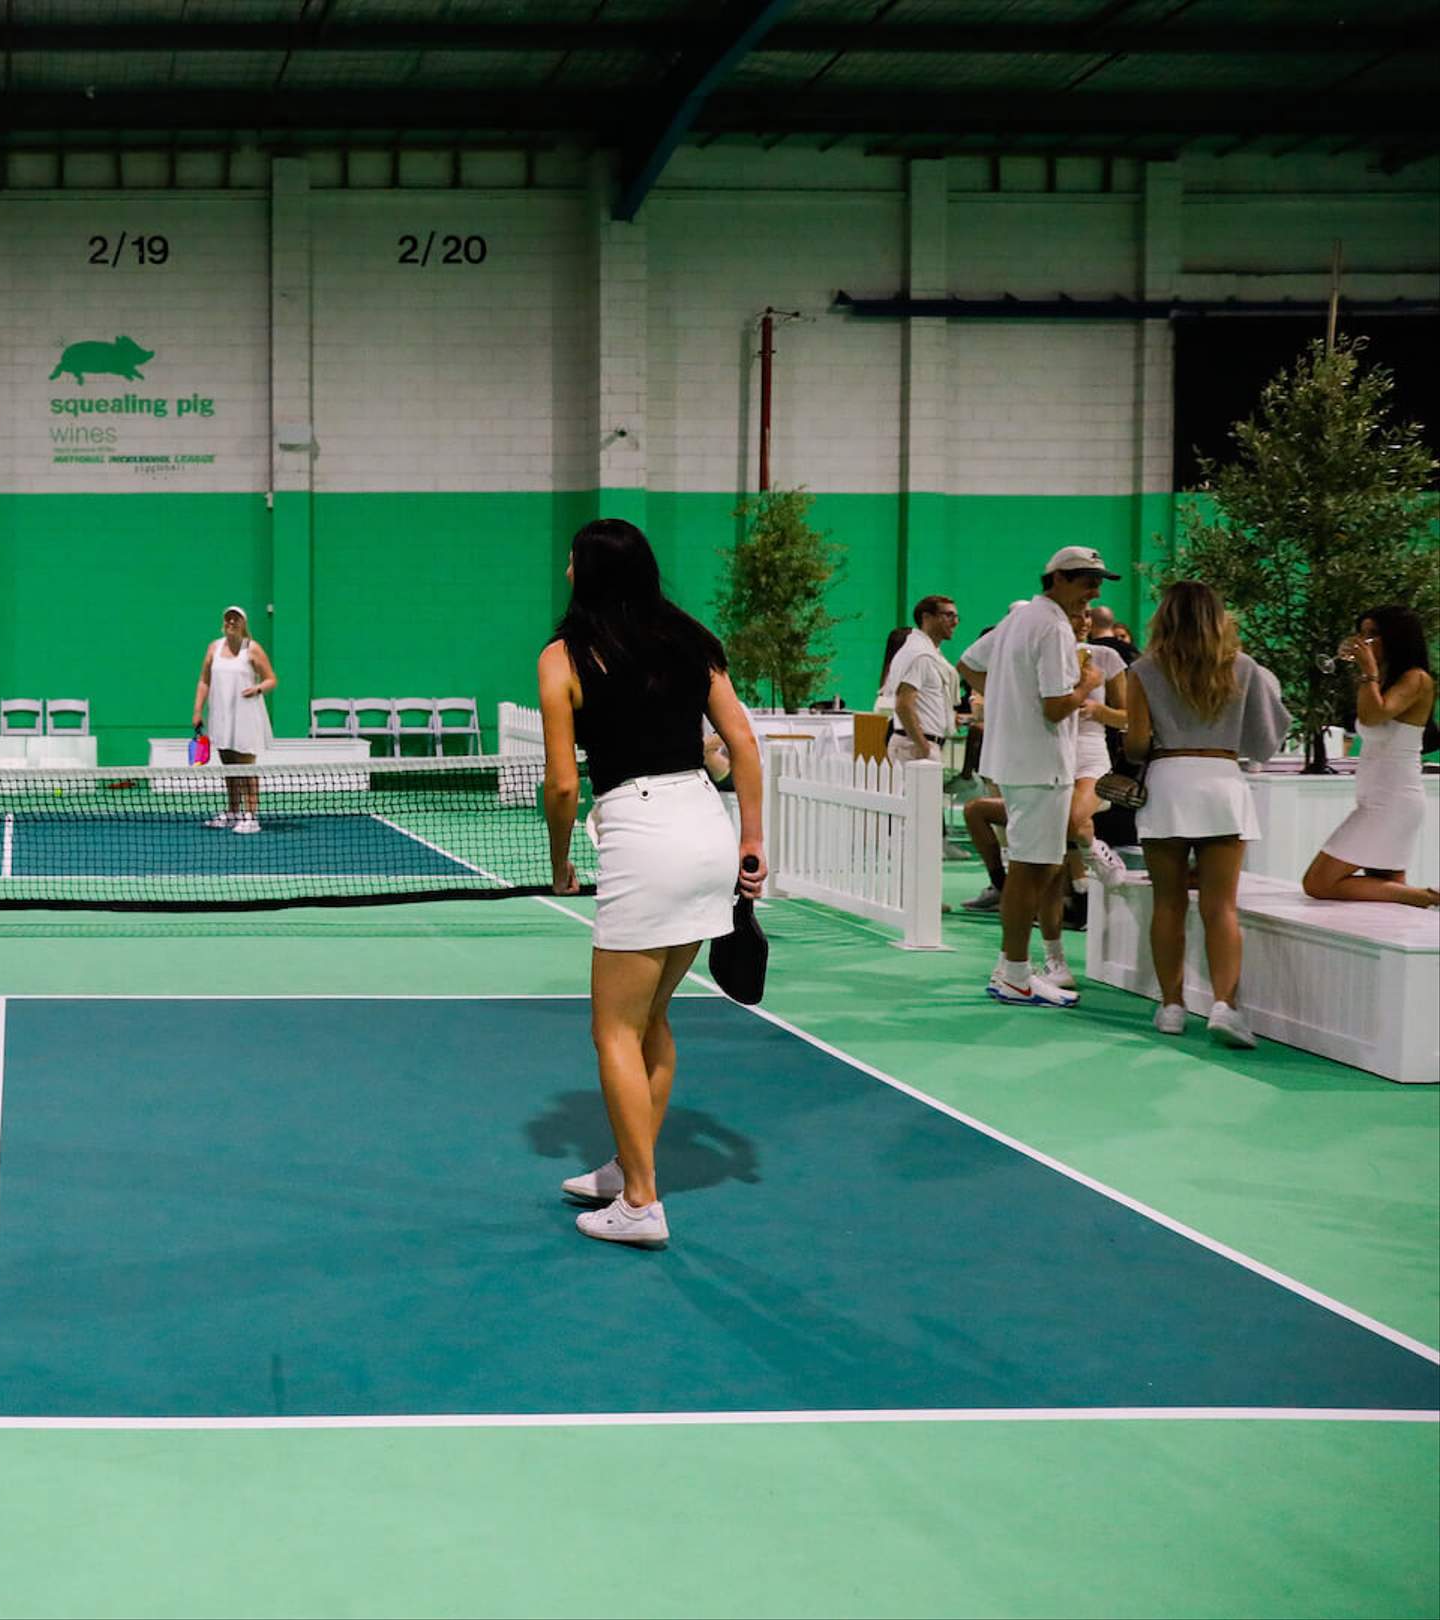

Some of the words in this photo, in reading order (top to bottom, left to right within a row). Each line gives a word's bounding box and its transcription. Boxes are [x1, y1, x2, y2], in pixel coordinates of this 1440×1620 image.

[88, 231, 169, 269] 2/19
[398, 231, 487, 267] 2/20
[50, 394, 168, 417] squealing
[177, 393, 215, 417] pig
[49, 423, 118, 444] wines
